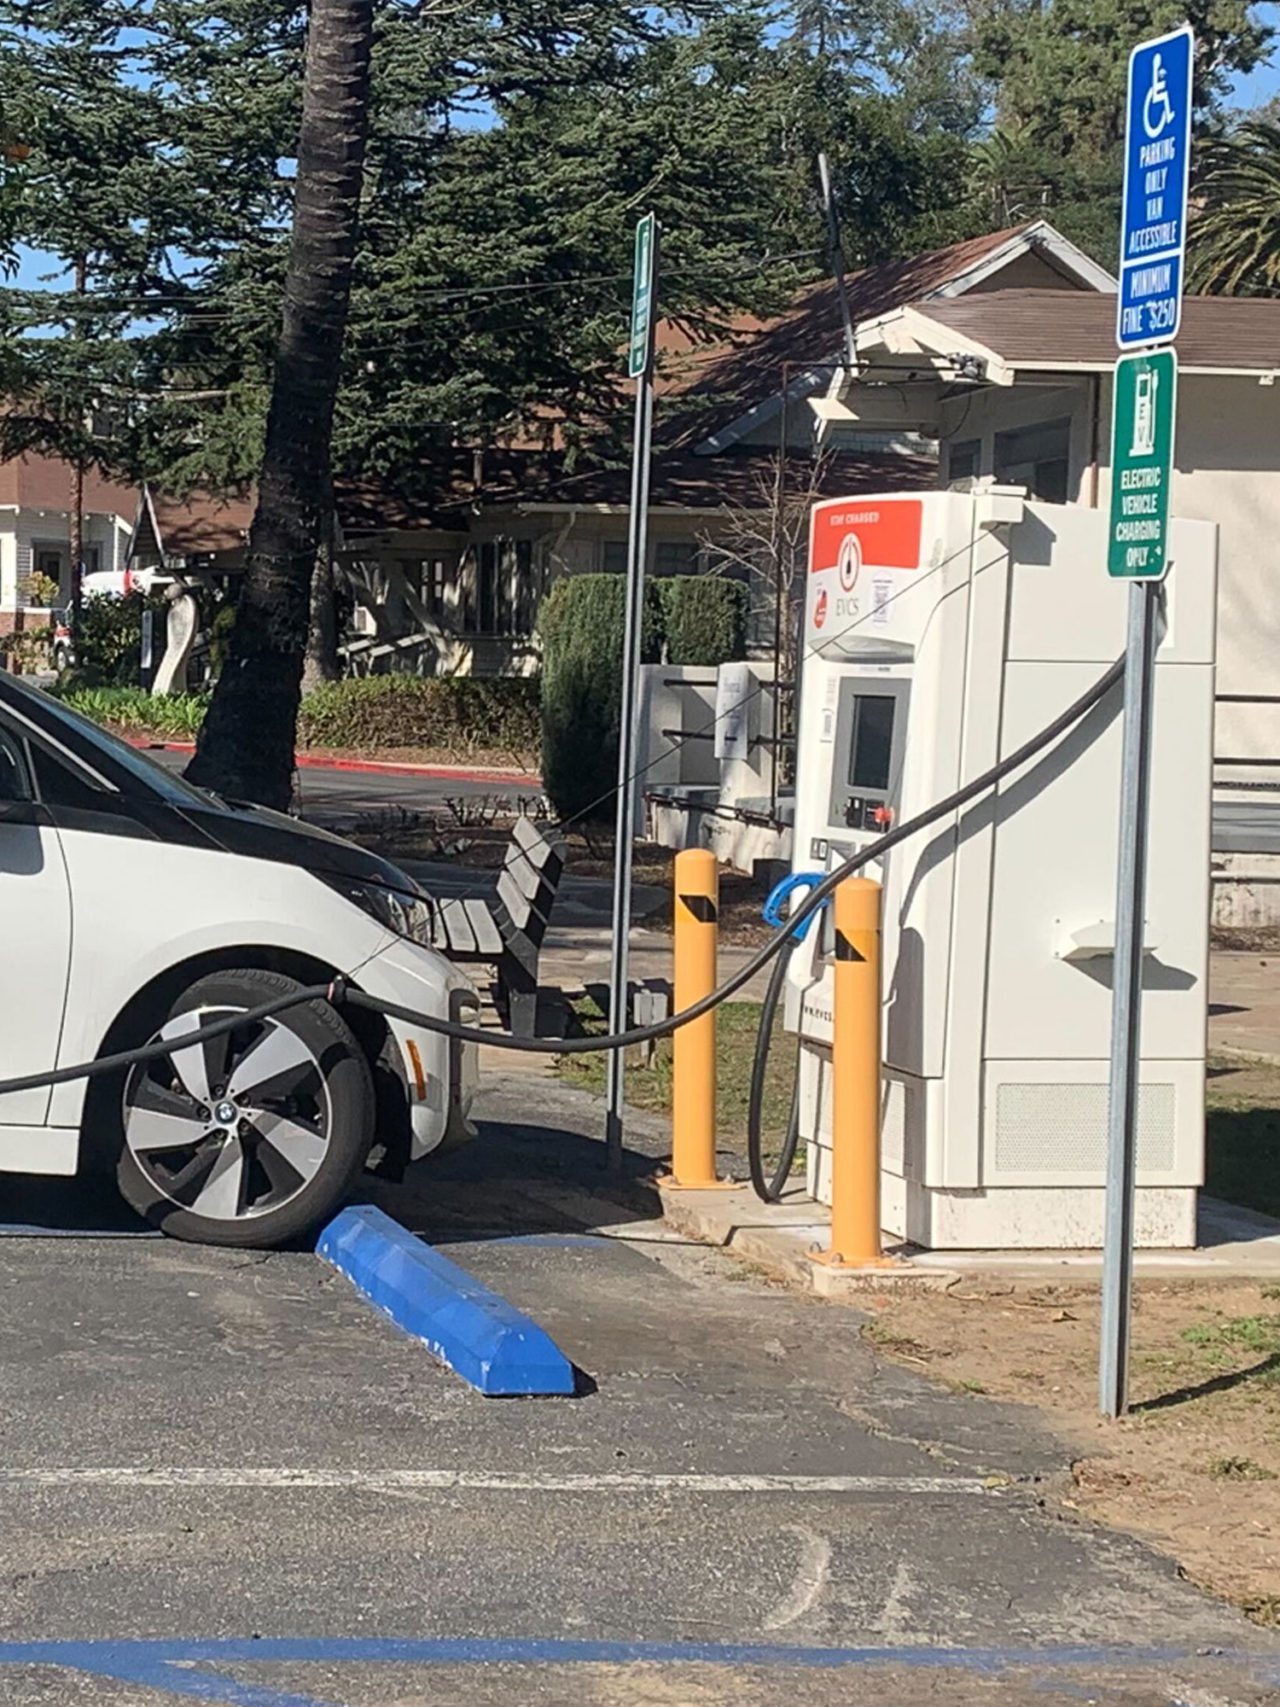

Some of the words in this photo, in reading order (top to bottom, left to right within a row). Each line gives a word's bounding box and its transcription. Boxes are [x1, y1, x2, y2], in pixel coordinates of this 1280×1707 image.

[1140, 137, 1175, 167] PARKING
[1145, 168, 1167, 193] ONLY
[1147, 198, 1163, 222] VAN
[1129, 221, 1177, 253] ACCESSIBLE
[1131, 264, 1171, 298] MINIMUM
[1123, 306, 1143, 335] FINE
[1148, 298, 1175, 331] $250
[1121, 467, 1161, 490] ELECTRIC
[1122, 494, 1158, 516] VEHICLE
[1116, 519, 1161, 541] CHARGING
[836, 598, 859, 616] EVCS
